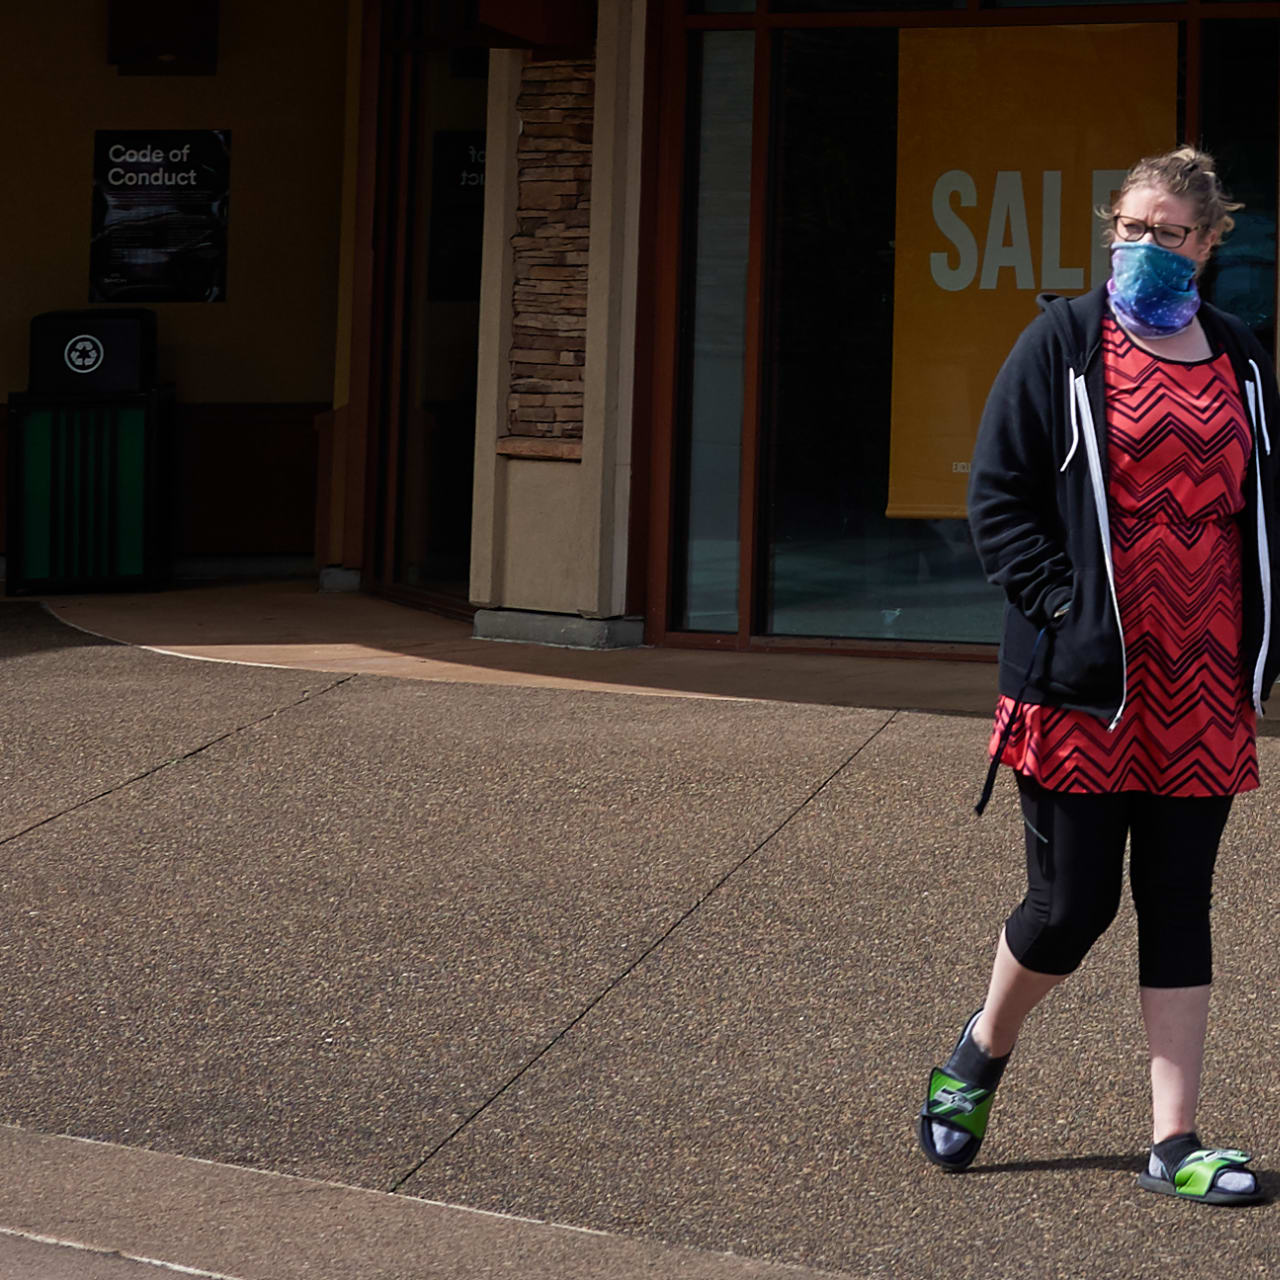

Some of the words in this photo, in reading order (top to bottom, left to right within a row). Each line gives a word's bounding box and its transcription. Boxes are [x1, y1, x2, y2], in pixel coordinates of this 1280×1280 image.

[108, 144, 164, 163] Code
[168, 144, 191, 163] of
[107, 167, 197, 186] Conduct
